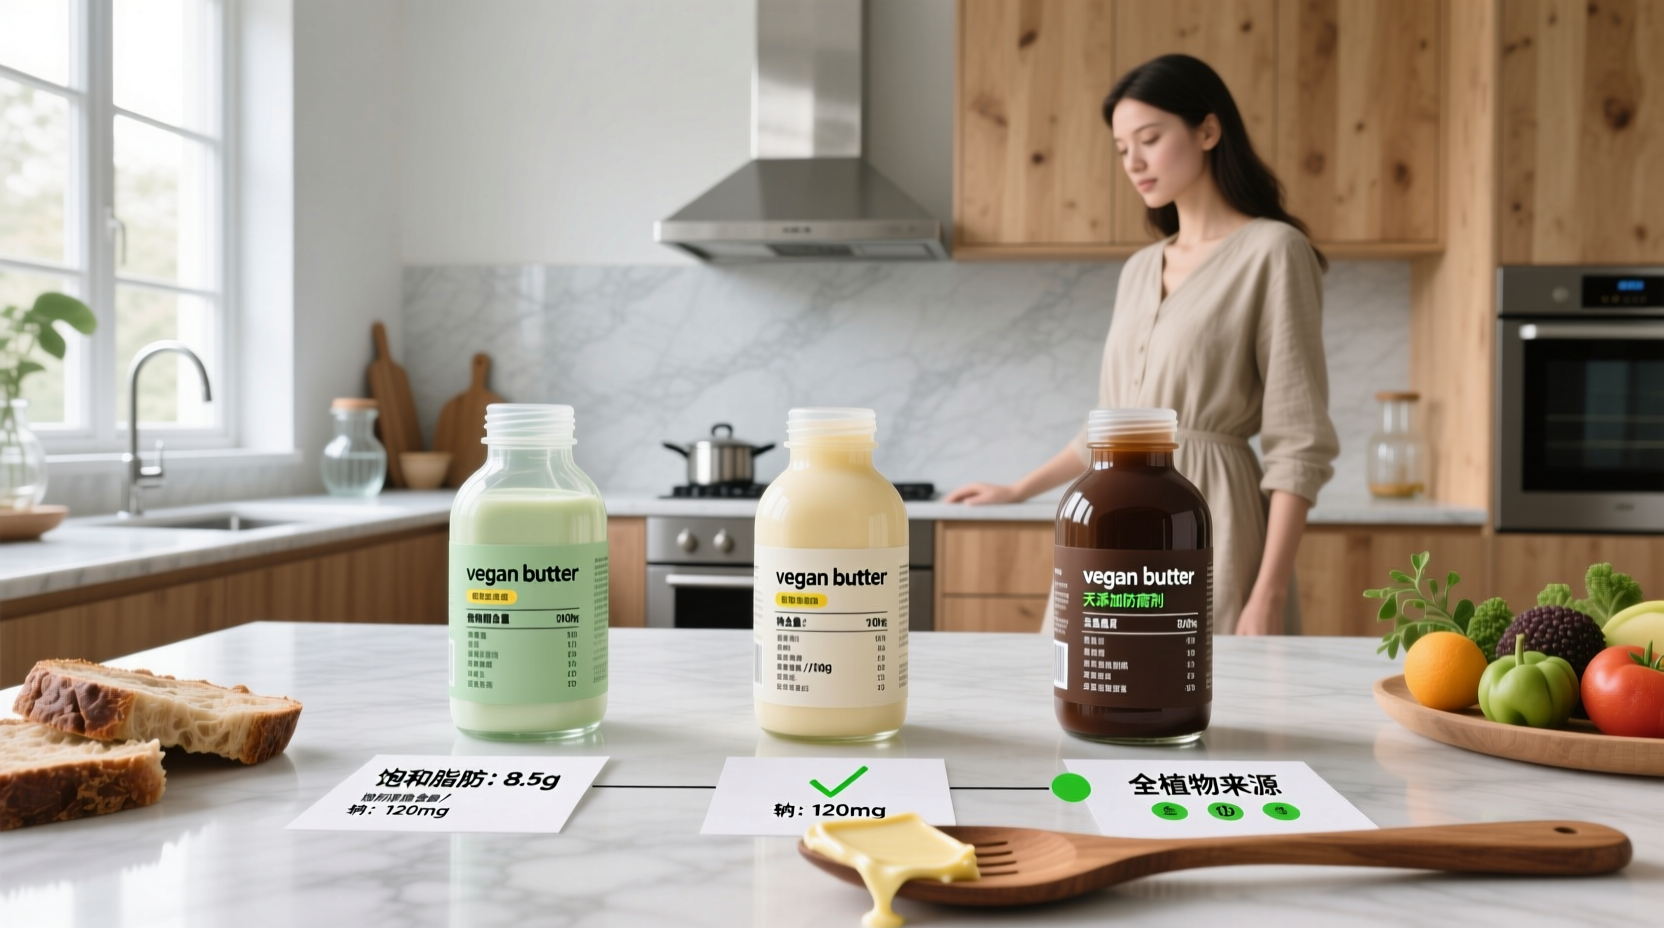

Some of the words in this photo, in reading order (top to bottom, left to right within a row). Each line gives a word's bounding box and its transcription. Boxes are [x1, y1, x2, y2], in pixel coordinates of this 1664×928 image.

[466, 567, 519, 586] vegan
[523, 564, 579, 582] butter
[776, 571, 829, 590] vegan
[833, 567, 888, 586] butter
[1083, 570, 1138, 590] vegan
[1143, 566, 1195, 586] butter
[1128, 772, 1283, 797] 全植物来源
[386, 805, 450, 819] 120mg
[812, 803, 886, 819] 120mg
